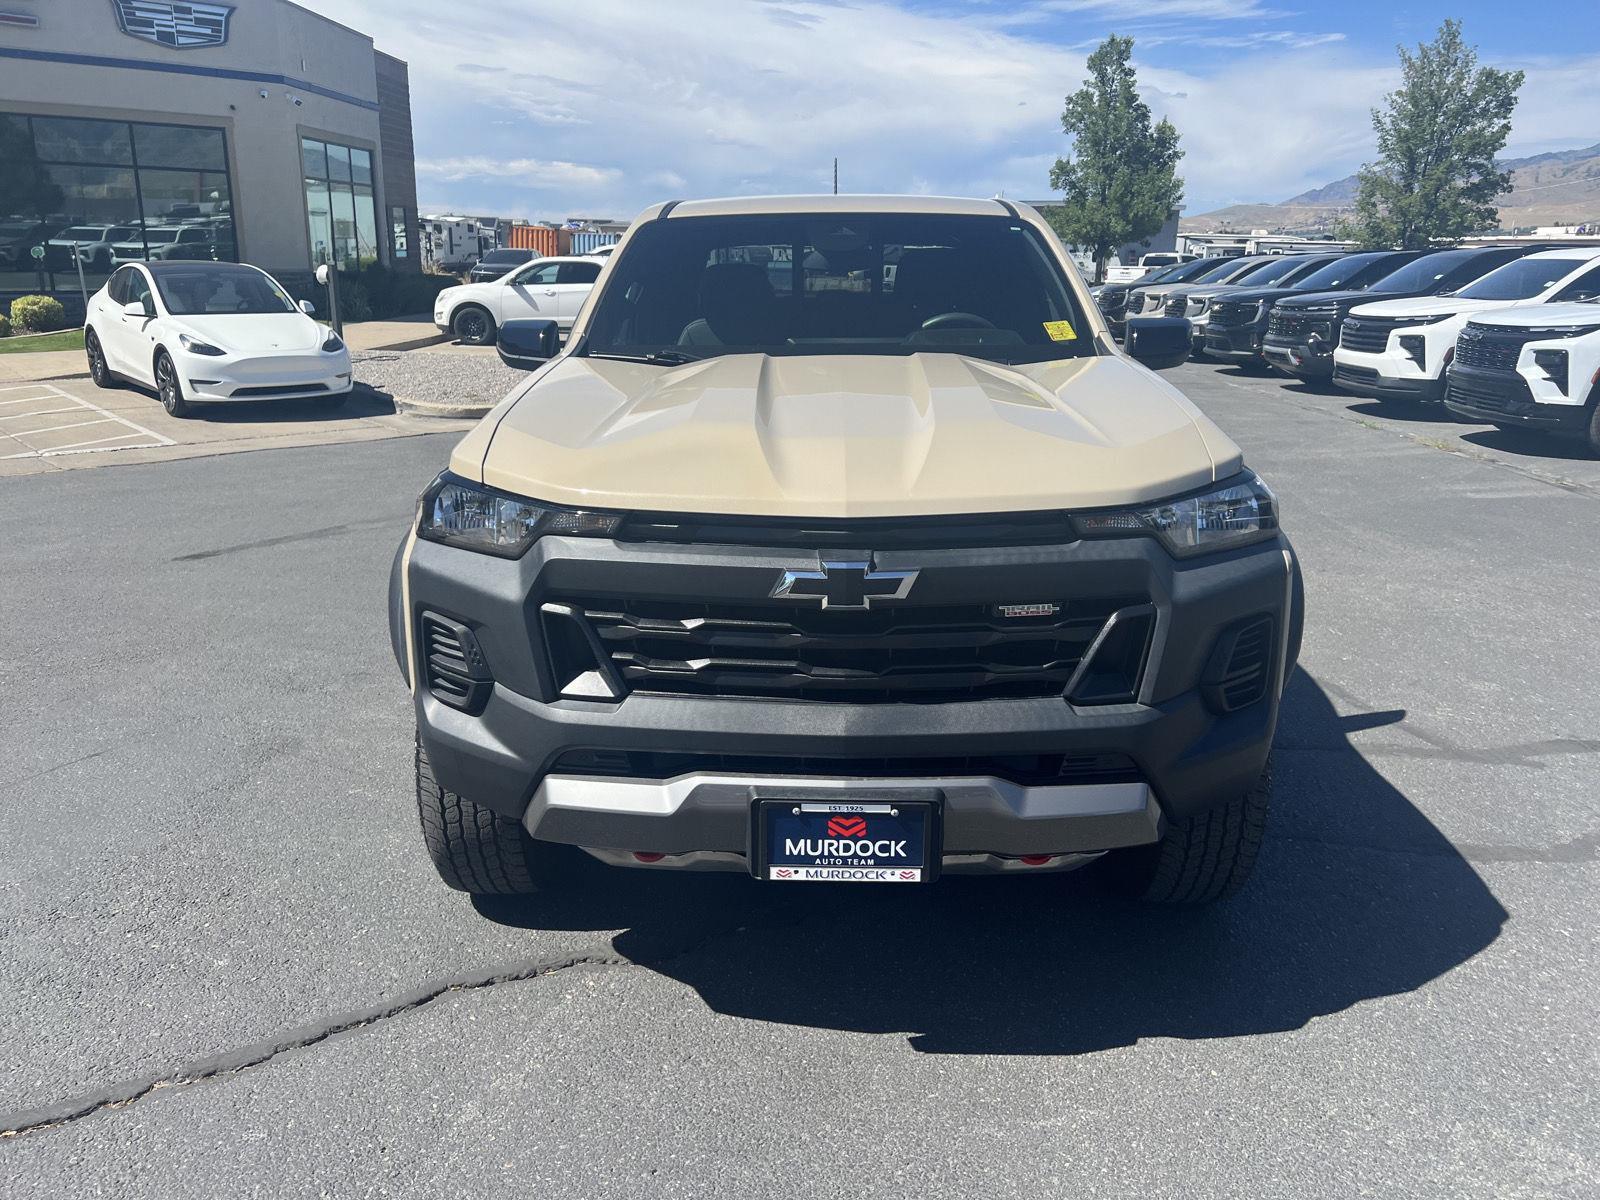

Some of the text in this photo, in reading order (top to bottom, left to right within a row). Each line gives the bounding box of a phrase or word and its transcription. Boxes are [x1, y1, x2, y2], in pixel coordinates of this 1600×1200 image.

[785, 838, 907, 857] MURDOCK
[847, 858, 875, 866] TEAM
[805, 869, 888, 880] MURDOCK
